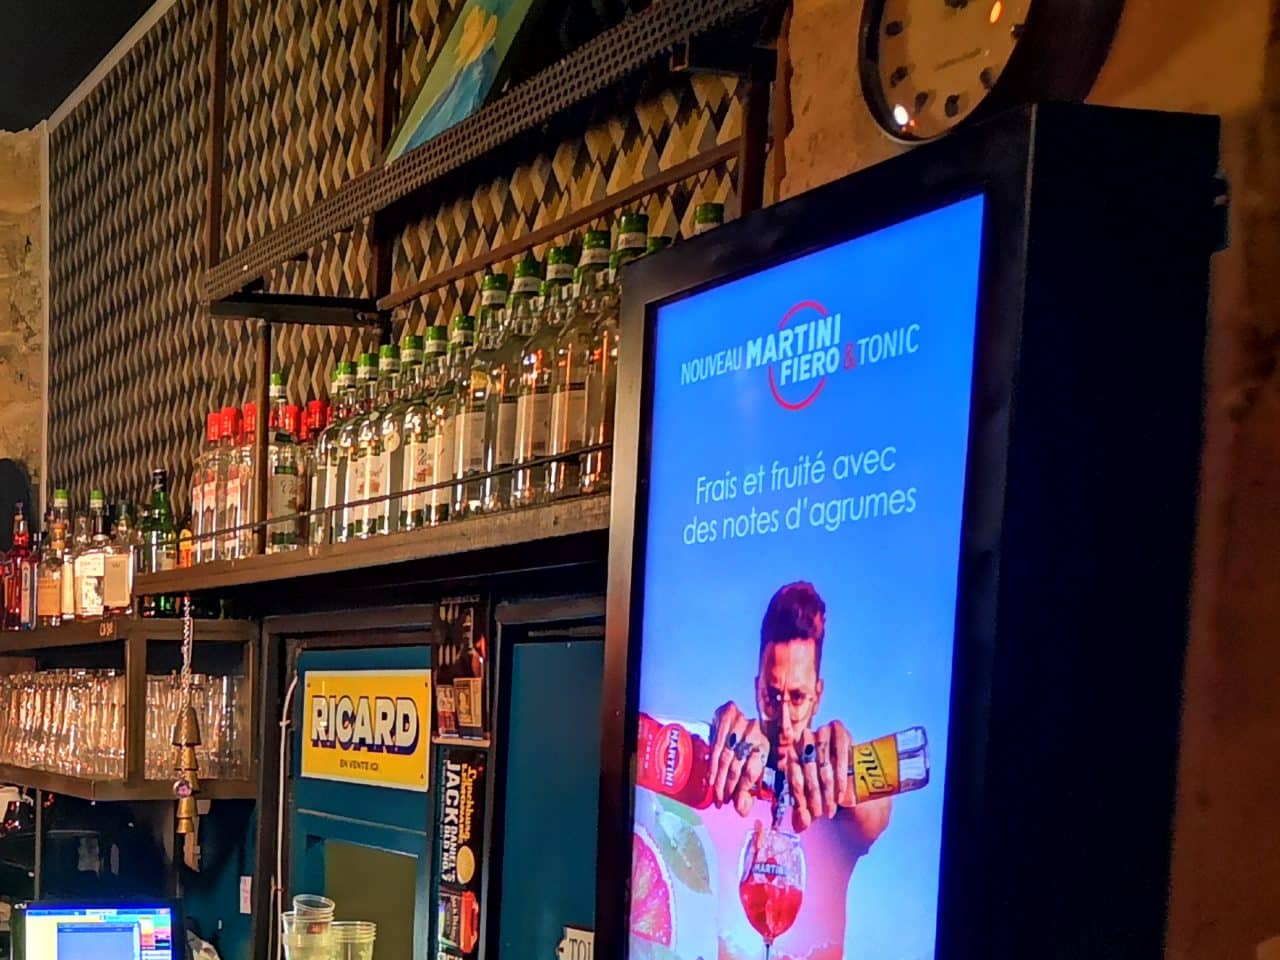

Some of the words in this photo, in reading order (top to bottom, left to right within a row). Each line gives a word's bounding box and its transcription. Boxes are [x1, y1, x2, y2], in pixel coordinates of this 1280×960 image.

[680, 346, 745, 385] NOUVEAU
[746, 313, 841, 370] MARTINI
[780, 347, 839, 386] FIERO
[858, 324, 921, 365] TONIC
[695, 470, 737, 505] Frais
[743, 464, 764, 494] et
[771, 451, 825, 488] fruité
[832, 445, 897, 480] avec
[683, 515, 718, 545] des
[722, 503, 780, 540] notes
[785, 485, 917, 532] d'agrumes
[311, 695, 419, 755] RICARD
[349, 760, 369, 771] VENTE
[661, 727, 681, 788] MARTINI
[443, 760, 461, 825] JACK
